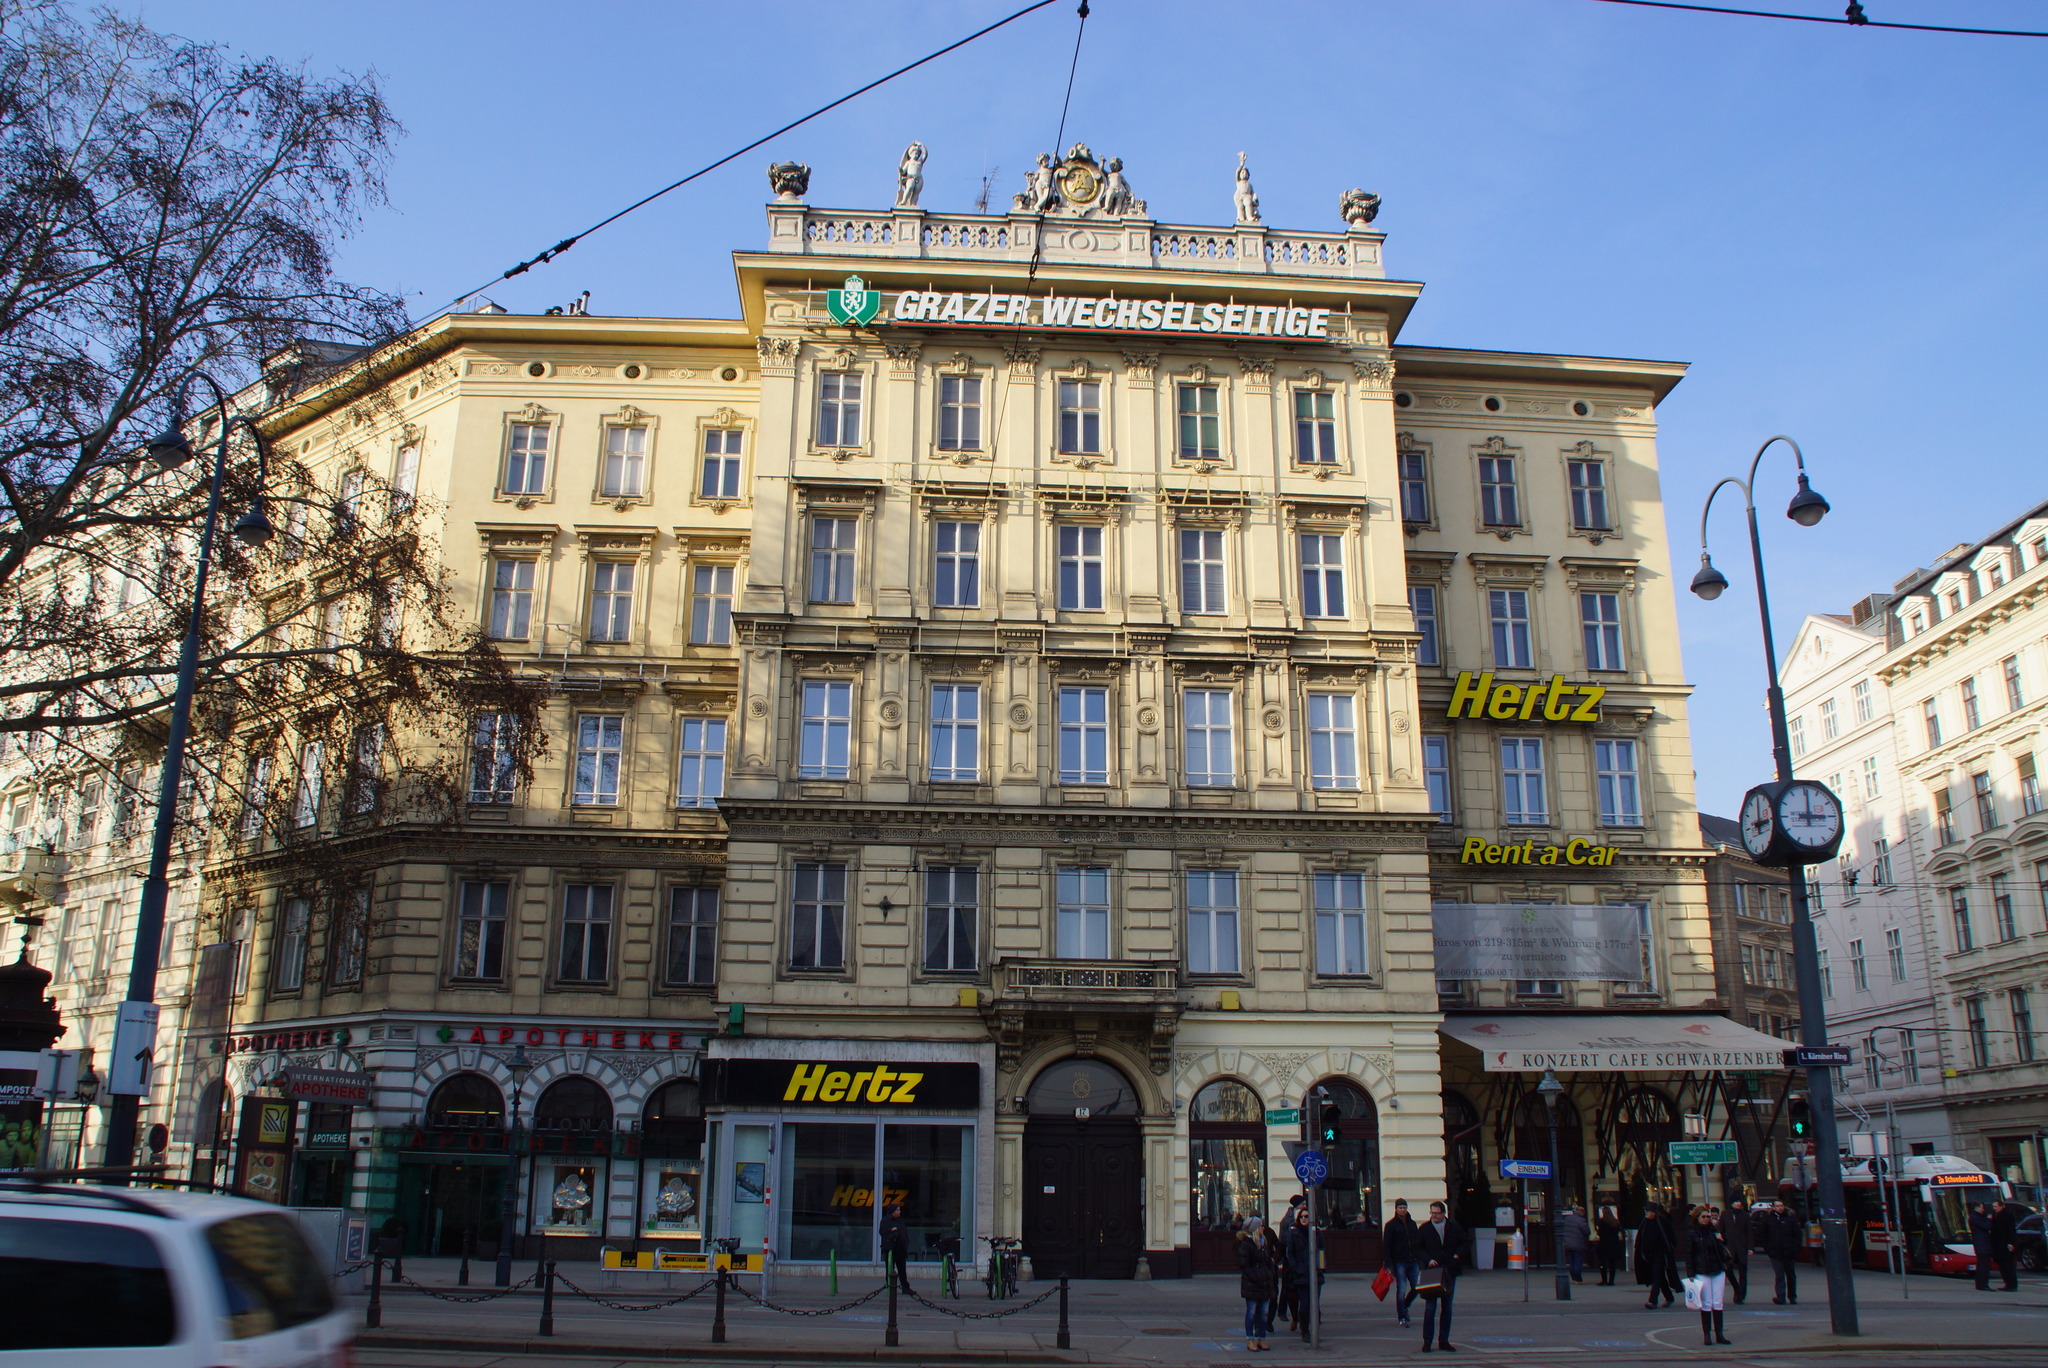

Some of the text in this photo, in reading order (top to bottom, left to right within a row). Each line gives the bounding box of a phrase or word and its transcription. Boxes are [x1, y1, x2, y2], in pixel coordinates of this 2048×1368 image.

[894, 289, 1330, 337] GRAZER WECHSELSEITIGE
[1446, 671, 1607, 722] Hertz
[1461, 837, 1621, 866] Rent a Car
[1463, 939, 1482, 948] von
[1540, 938, 1549, 948] &
[1551, 938, 1601, 951] Wohnung
[1501, 953, 1568, 962] zu vermieten
[1435, 968, 1448, 977] el.:
[1450, 968, 1471, 977] 0660
[226, 1029, 329, 1053] APOTHEKE
[469, 1026, 683, 1050] APOTHEKE
[1522, 1051, 1785, 1067] KONZERT CAFE SCHWARZENBER
[1833, 1052, 1848, 1062] Ring
[291, 1073, 367, 1086] INTERNATIONALE
[783, 1063, 924, 1103] Hertz
[291, 1082, 367, 1100] APOTHEKE
[411, 1113, 641, 1132] INTERNATIONALE
[312, 1133, 347, 1143] APOTHEKE
[411, 1130, 640, 1154] APOTHEKE
[550, 1157, 592, 1165] SEIT 1870
[659, 1160, 700, 1168] SEIT 1870
[1517, 1165, 1546, 1174] EINBAHN
[830, 1184, 910, 1207] Hertz
